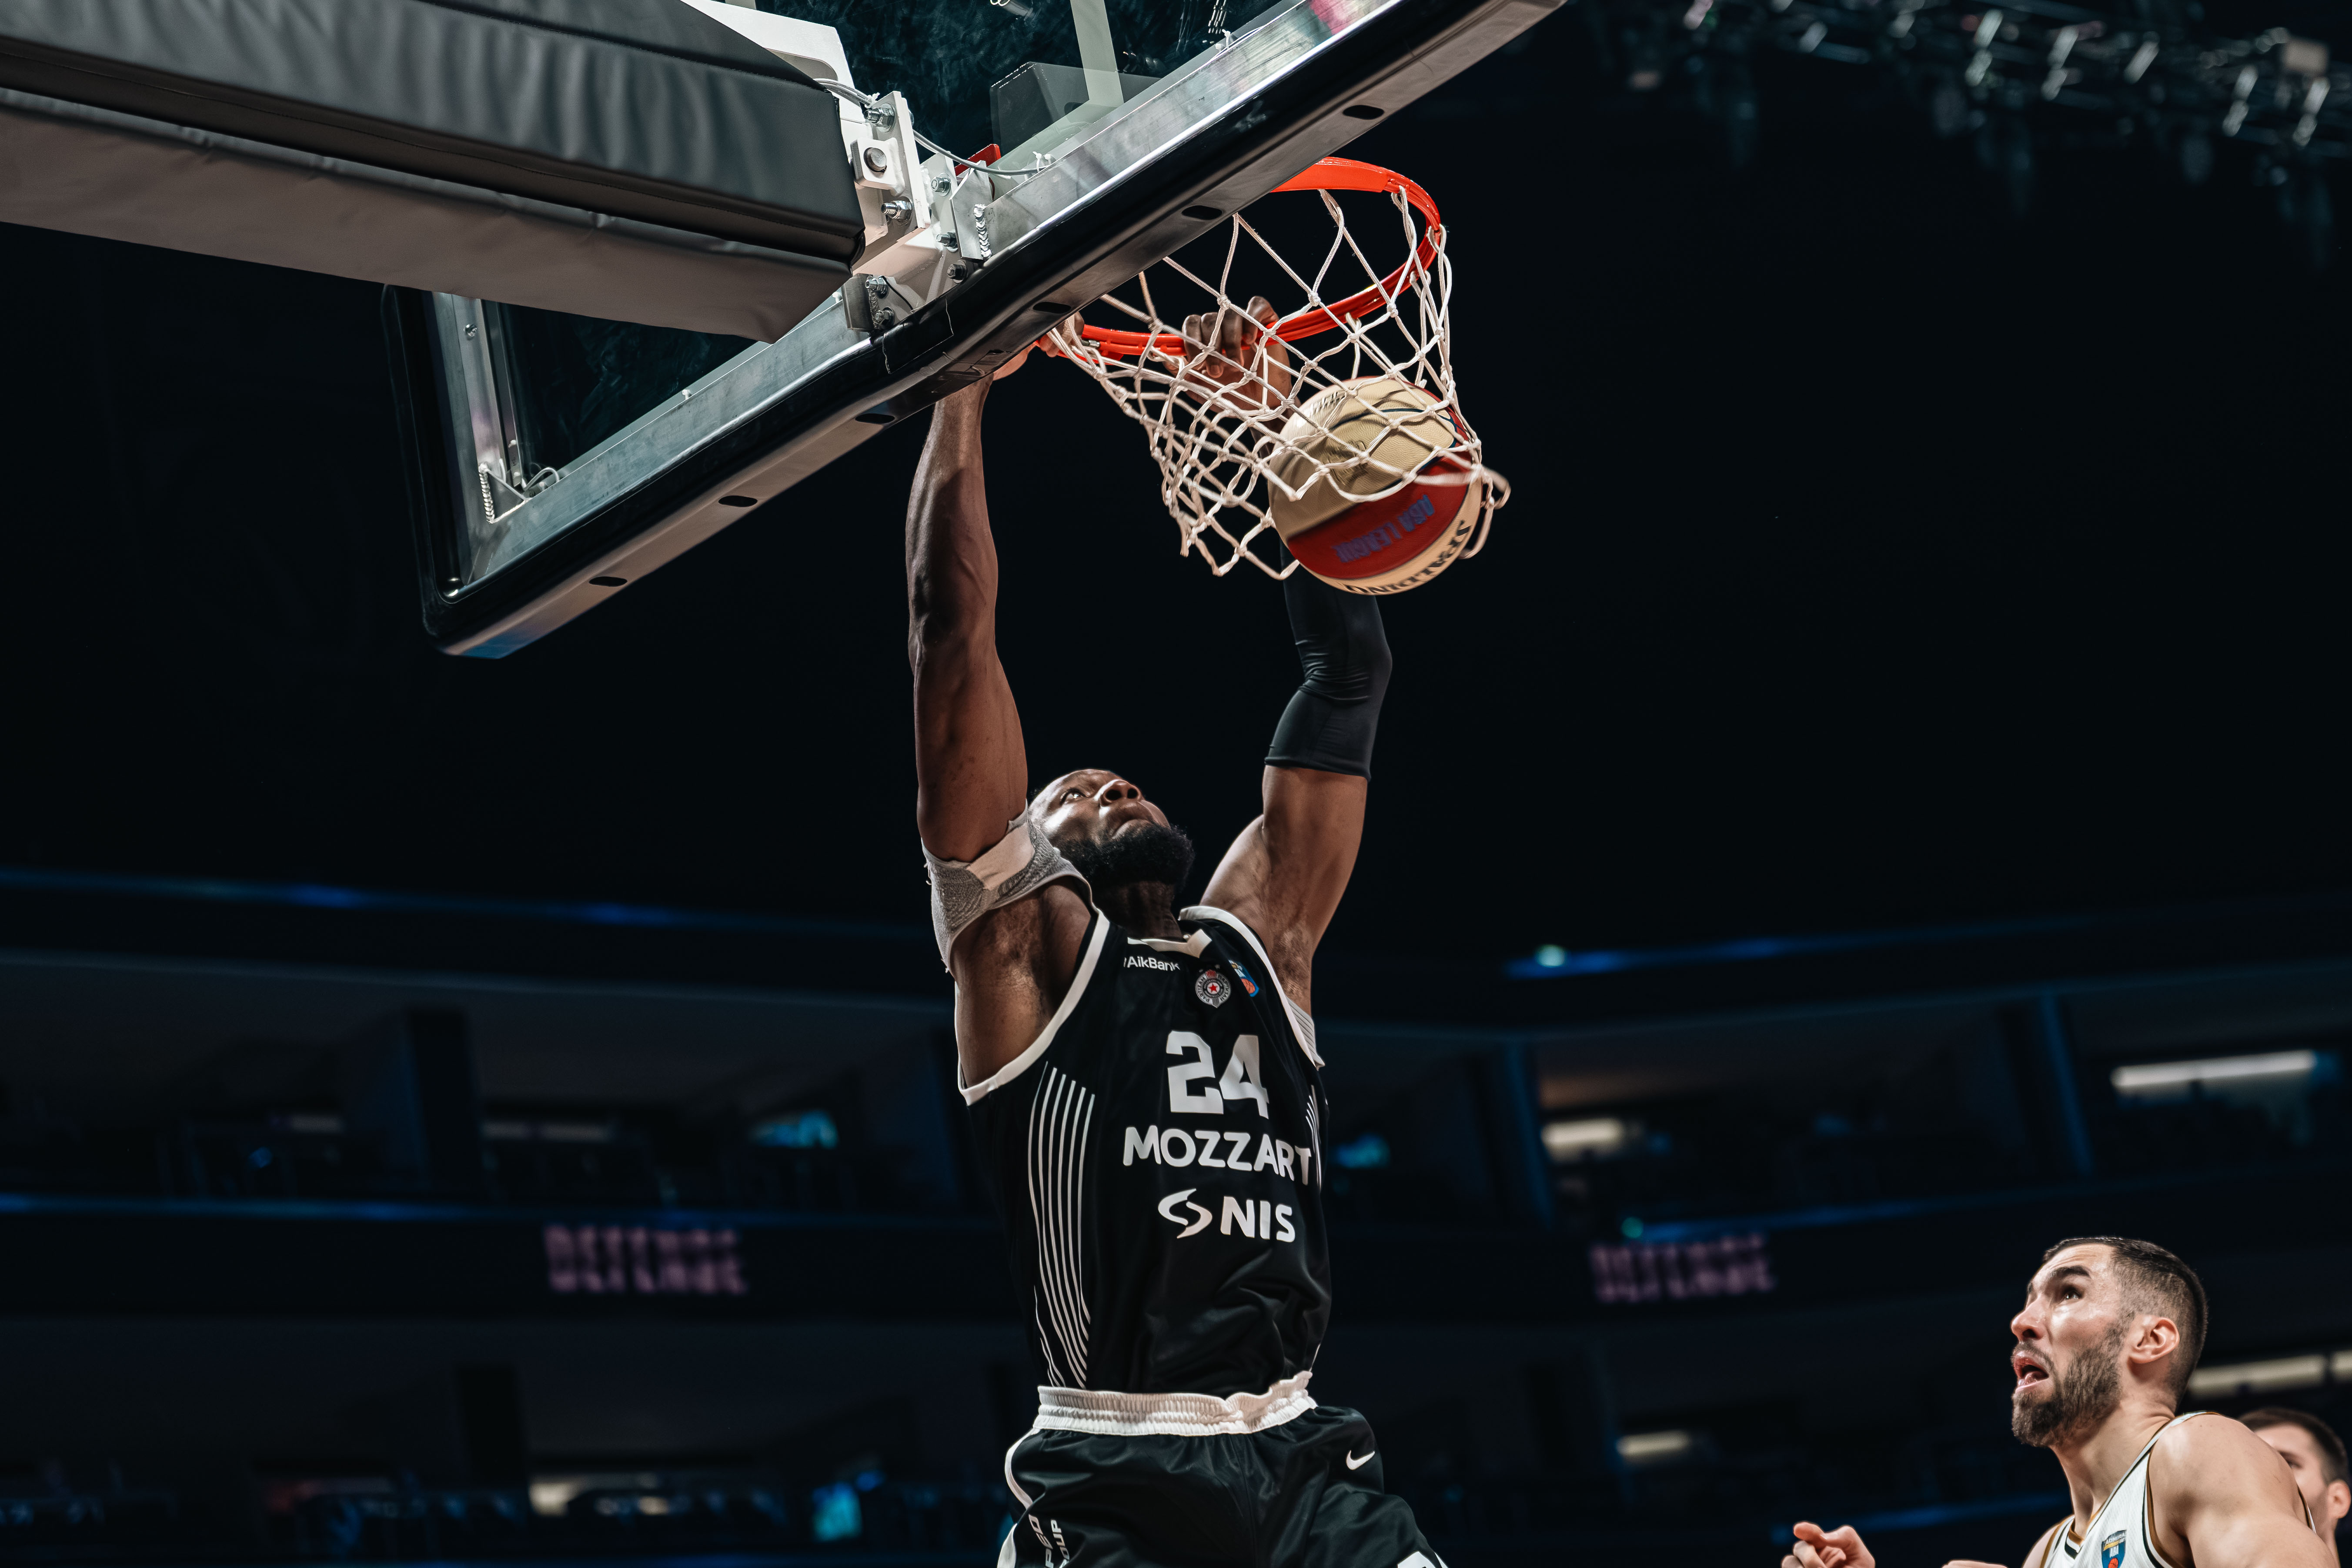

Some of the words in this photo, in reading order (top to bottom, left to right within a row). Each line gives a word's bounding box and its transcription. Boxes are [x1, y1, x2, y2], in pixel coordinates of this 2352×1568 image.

[1166, 1030, 1269, 1119] 24
[1123, 1125, 1311, 1185] MOZZART
[1220, 1196, 1296, 1242] NIS
